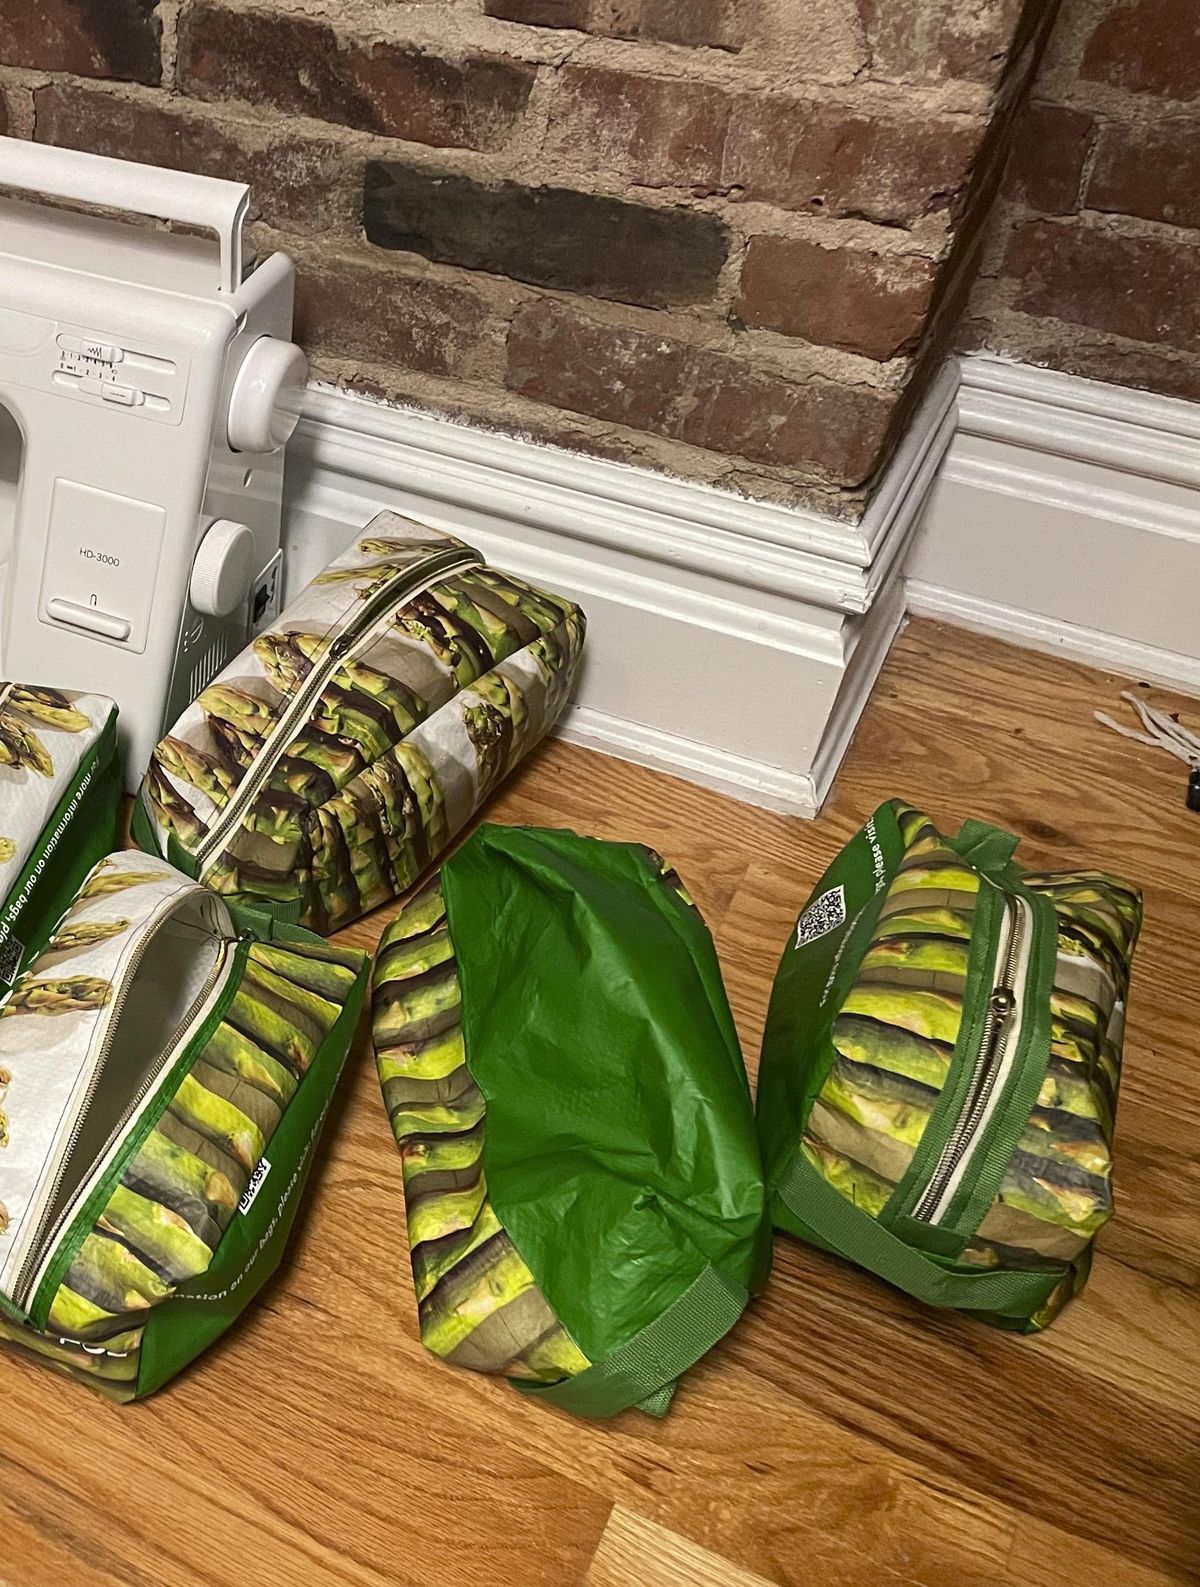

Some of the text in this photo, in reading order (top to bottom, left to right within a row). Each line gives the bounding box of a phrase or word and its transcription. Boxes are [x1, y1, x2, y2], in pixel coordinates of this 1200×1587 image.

[79, 547, 120, 568] HD-3000
[75, 773, 92, 800] more
[42, 799, 79, 860] information
[34, 859, 46, 875] on
[23, 874, 37, 896] our
[4, 893, 29, 922] bags,
